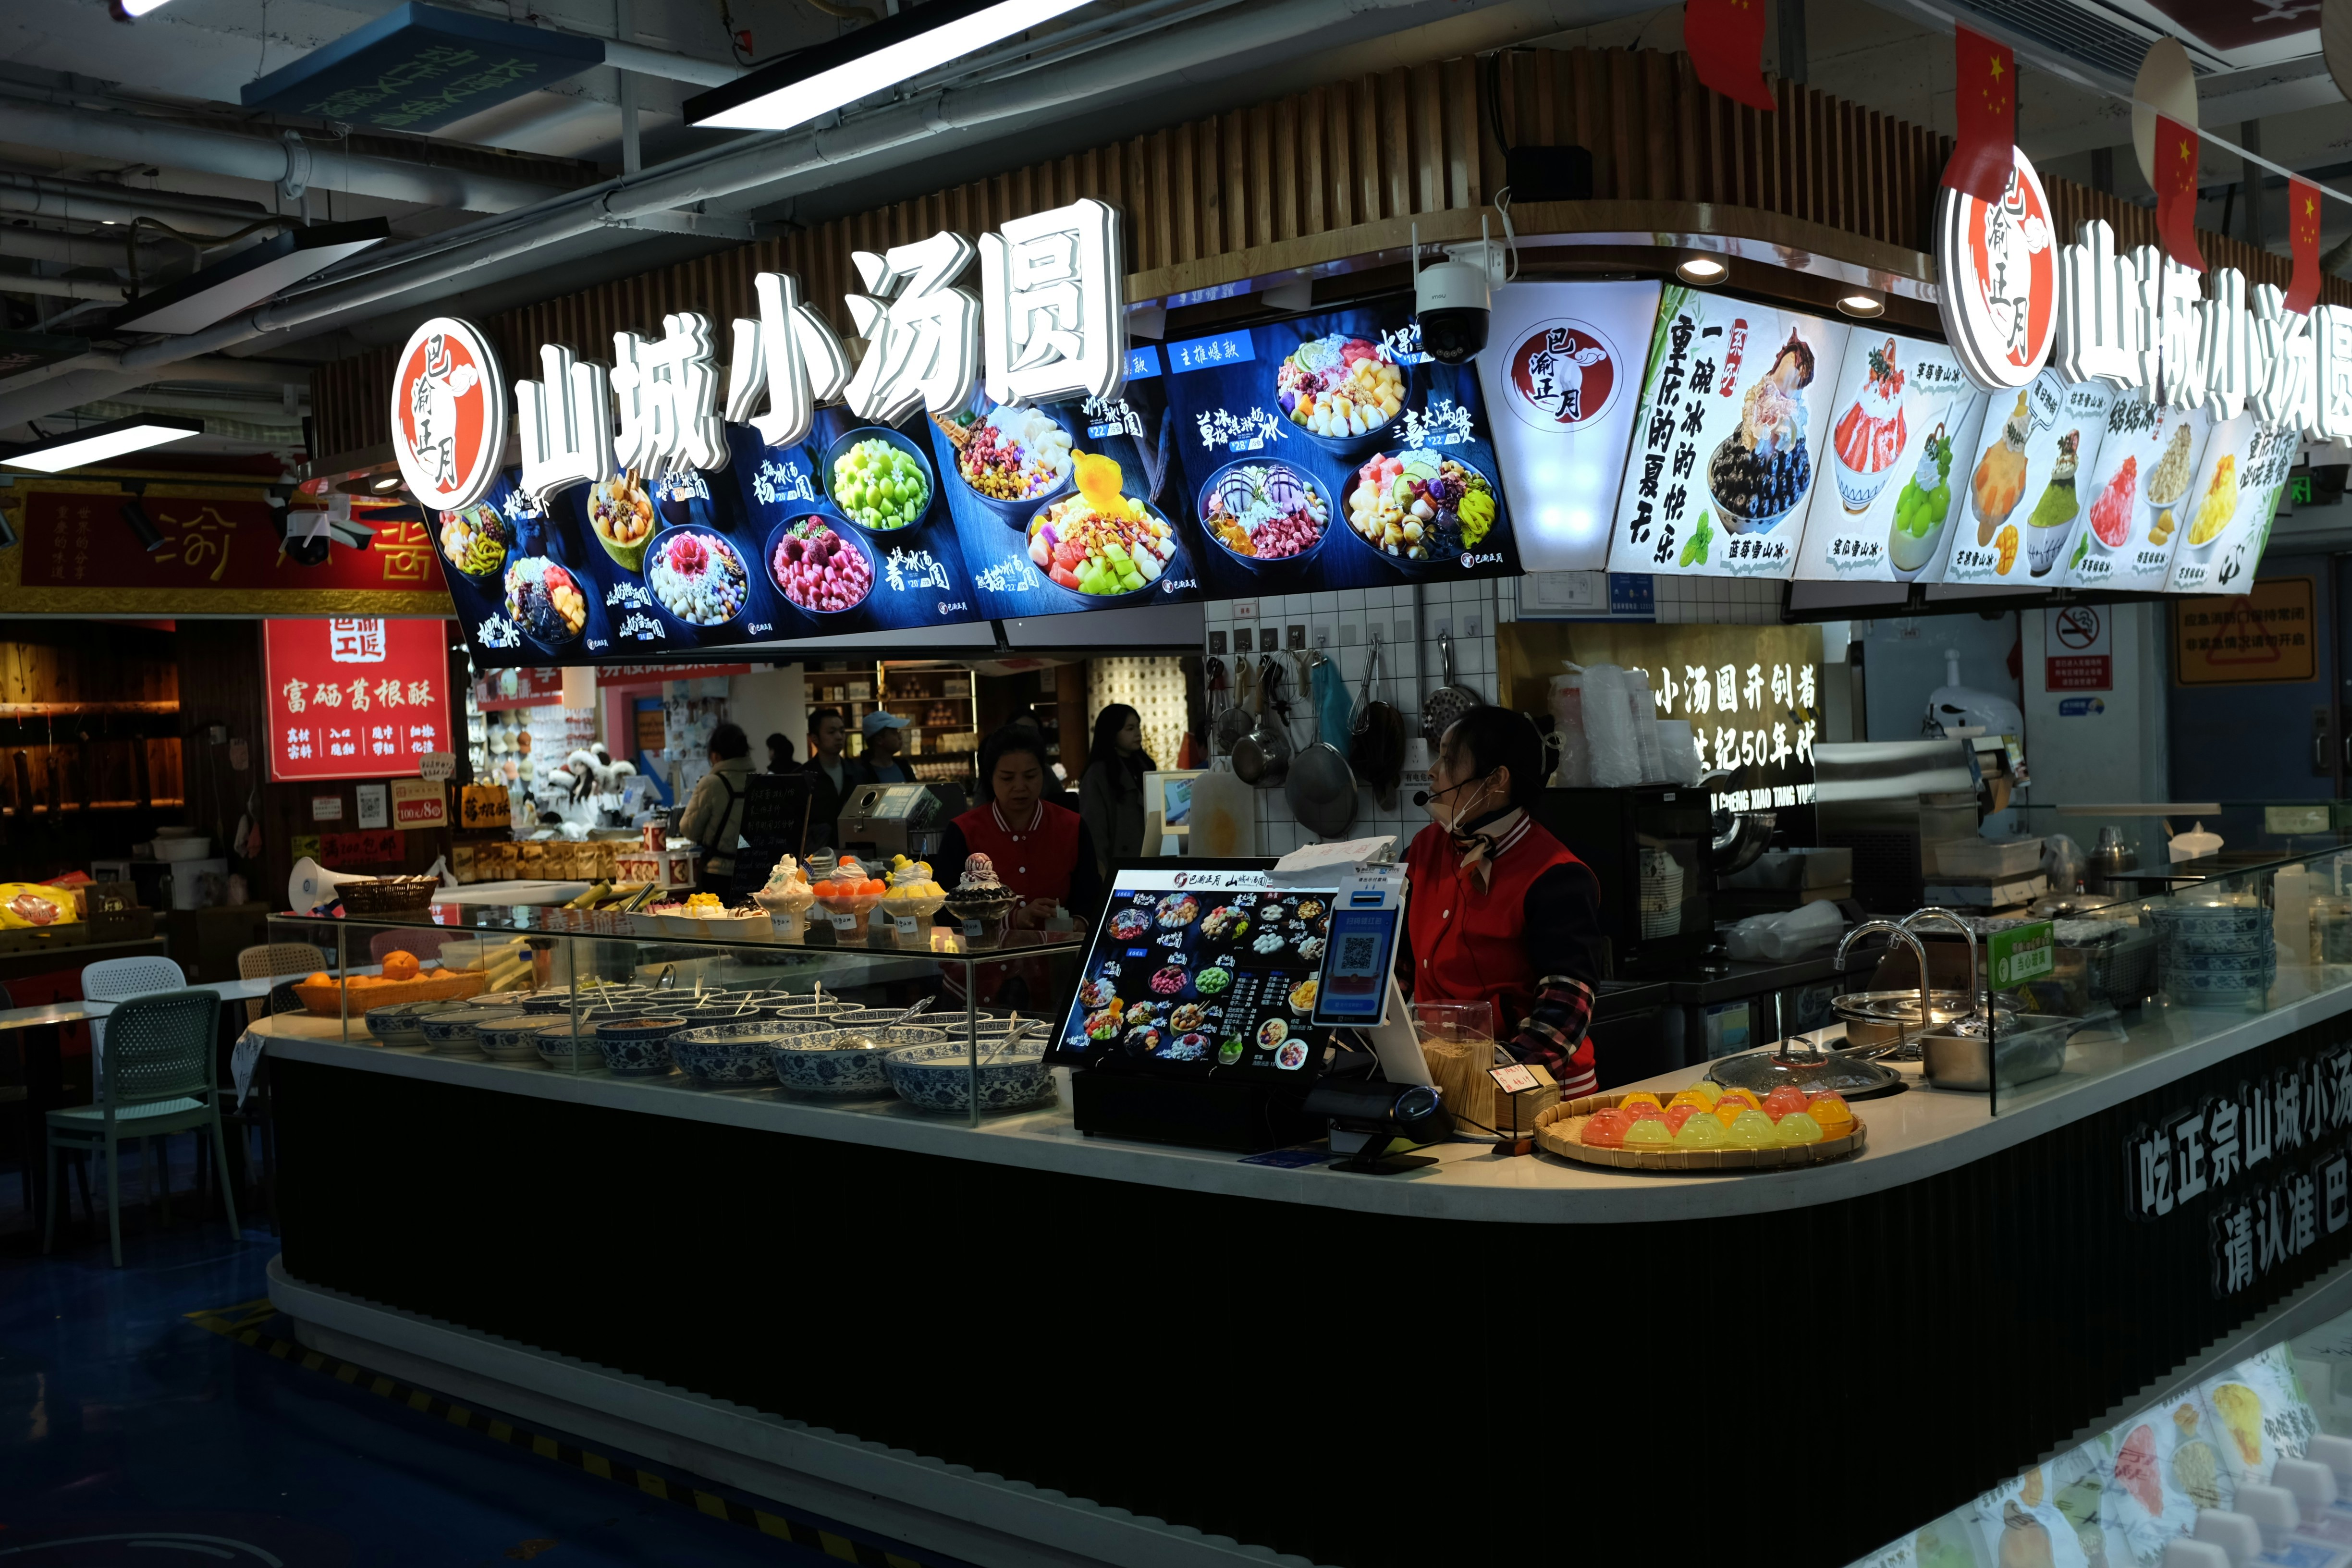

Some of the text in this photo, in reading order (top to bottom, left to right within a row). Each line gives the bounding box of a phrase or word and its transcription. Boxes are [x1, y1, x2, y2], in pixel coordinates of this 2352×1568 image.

[515, 198, 1119, 492] 山城小汤圆
[1180, 340, 1239, 366] 主推爆款
[1722, 327, 1744, 389] 系列
[1529, 327, 1580, 419] 巴渝正月
[1917, 362, 1960, 383] 草莓雪山冰
[414, 334, 454, 484] 巴渝正月
[2108, 400, 2156, 436] 绵绵冰
[1392, 399, 1476, 449] 三喜大满贯
[1629, 315, 1695, 544] 重庆的夏天
[1654, 326, 1723, 564] 一碗冰的快乐
[2248, 426, 2295, 460] 重庆打卡
[752, 459, 815, 505] 杨梅冰汤圆
[1475, 552, 1503, 563] 巴渝正月
[1728, 539, 1785, 560] 蓝莓雪山冰
[1833, 538, 1877, 557] 蜜瓜雪山冰
[885, 546, 950, 591] 青提冰汤圆
[1174, 579, 1197, 589] 巴渝正月
[2185, 607, 2305, 626] 应急消防门保持常闭
[336, 634, 382, 657] 工匠
[2185, 632, 2305, 651] 非紧急情况请勿开启
[283, 677, 435, 714] 富硒葛根酥
[1644, 662, 1815, 714] 小汤圆开创者
[1719, 790, 1749, 812] CHENG
[1751, 788, 1772, 809] XIAO
[1773, 785, 1795, 807] TANG
[323, 836, 396, 858] 满200包邮
[1189, 874, 1267, 887] 巴渝正月 山城小汤圆
[1346, 917, 1382, 926] 扫码领红包
[2018, 950, 2046, 971] 当心玻璃
